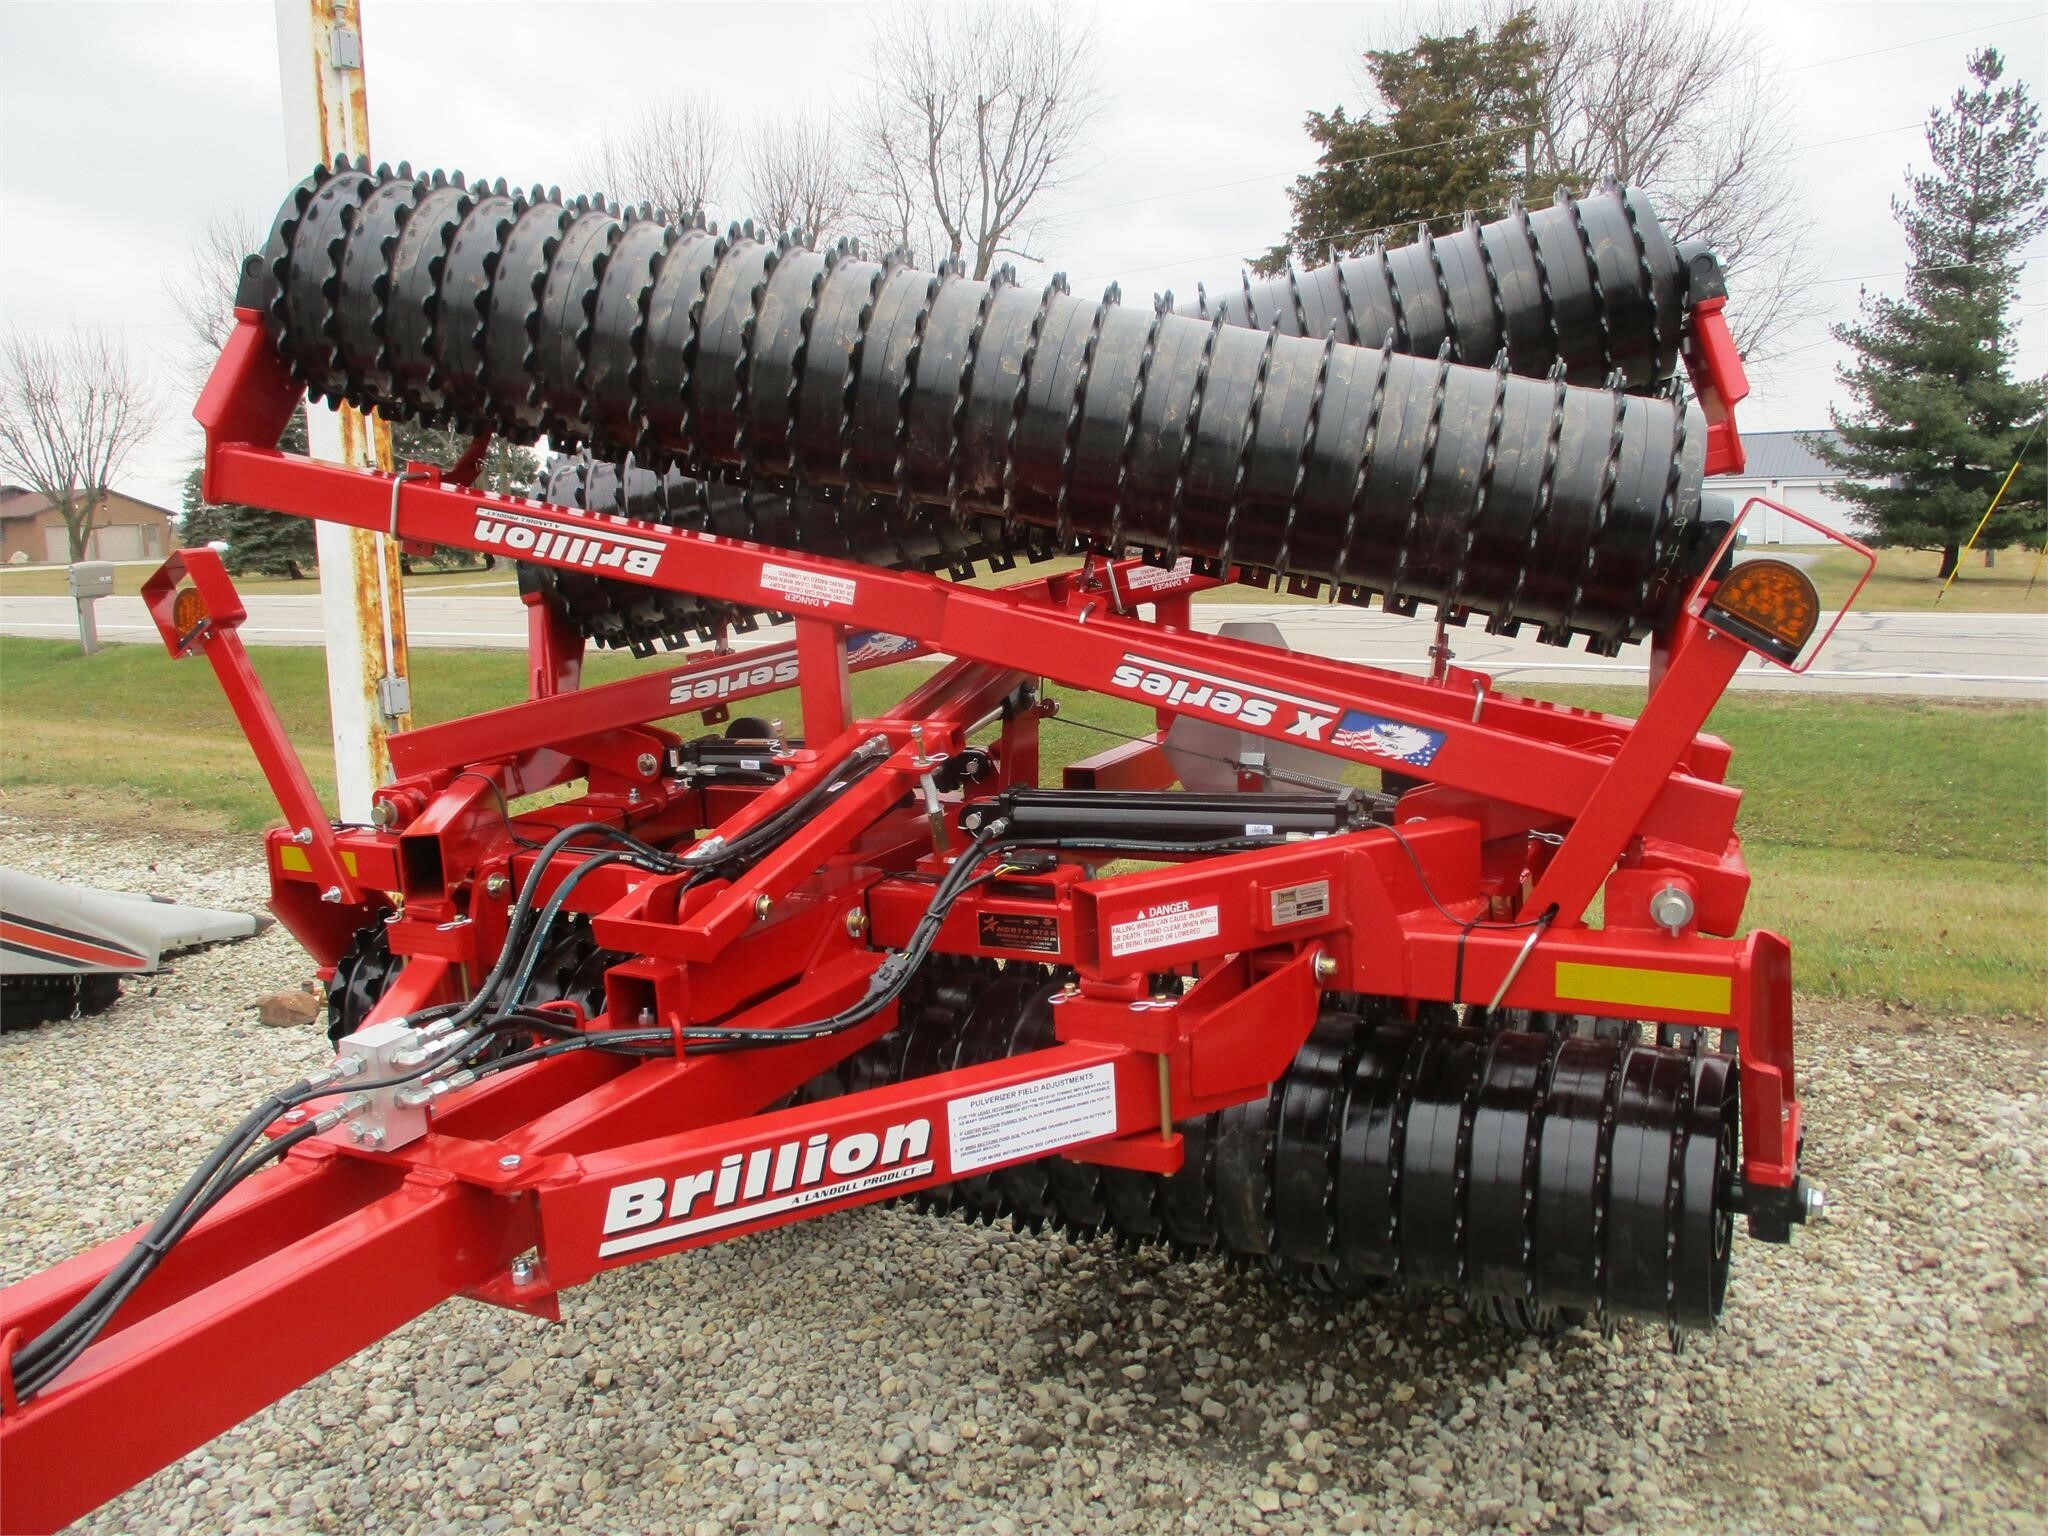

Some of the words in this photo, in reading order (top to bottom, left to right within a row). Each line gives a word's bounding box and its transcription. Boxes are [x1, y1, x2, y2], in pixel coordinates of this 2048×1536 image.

[473, 519, 662, 577] Brillion
[811, 583, 826, 591] STAND
[1152, 579, 1182, 591] DANGER
[784, 593, 820, 606] DANGER
[832, 594, 852, 602] FALLING
[669, 659, 800, 705] Series
[1111, 664, 1278, 727] Series
[1284, 710, 1333, 742] X
[1149, 901, 1189, 917] DANGER
[996, 926, 1028, 934] NORTH
[1112, 924, 1134, 934] FALLING
[1137, 920, 1154, 929] WINGS
[1169, 914, 1186, 923] CAUSE
[1189, 910, 1206, 919] INJURY
[1143, 927, 1160, 936] STAND
[1163, 923, 1180, 932] CLEAR
[1182, 920, 1198, 928] WHEN
[1200, 916, 1216, 925] WINGS
[1113, 942, 1123, 950] ARE
[1125, 939, 1141, 948] BEING
[1144, 934, 1163, 944] RAISED
[1174, 927, 1200, 938] LOWERED
[970, 1091, 1015, 1108] PULVERIZER
[1018, 1085, 1039, 1096] FIELD
[1040, 1072, 1093, 1091] ADJUSTMENTS
[988, 1152, 1001, 1160] MORE
[1002, 1144, 1033, 1156] INFORMATION
[602, 1117, 931, 1235] Brillion
[791, 1195, 800, 1205] A
[804, 1181, 859, 1202] LANDOLL
[863, 1166, 916, 1187] PRODUCT
